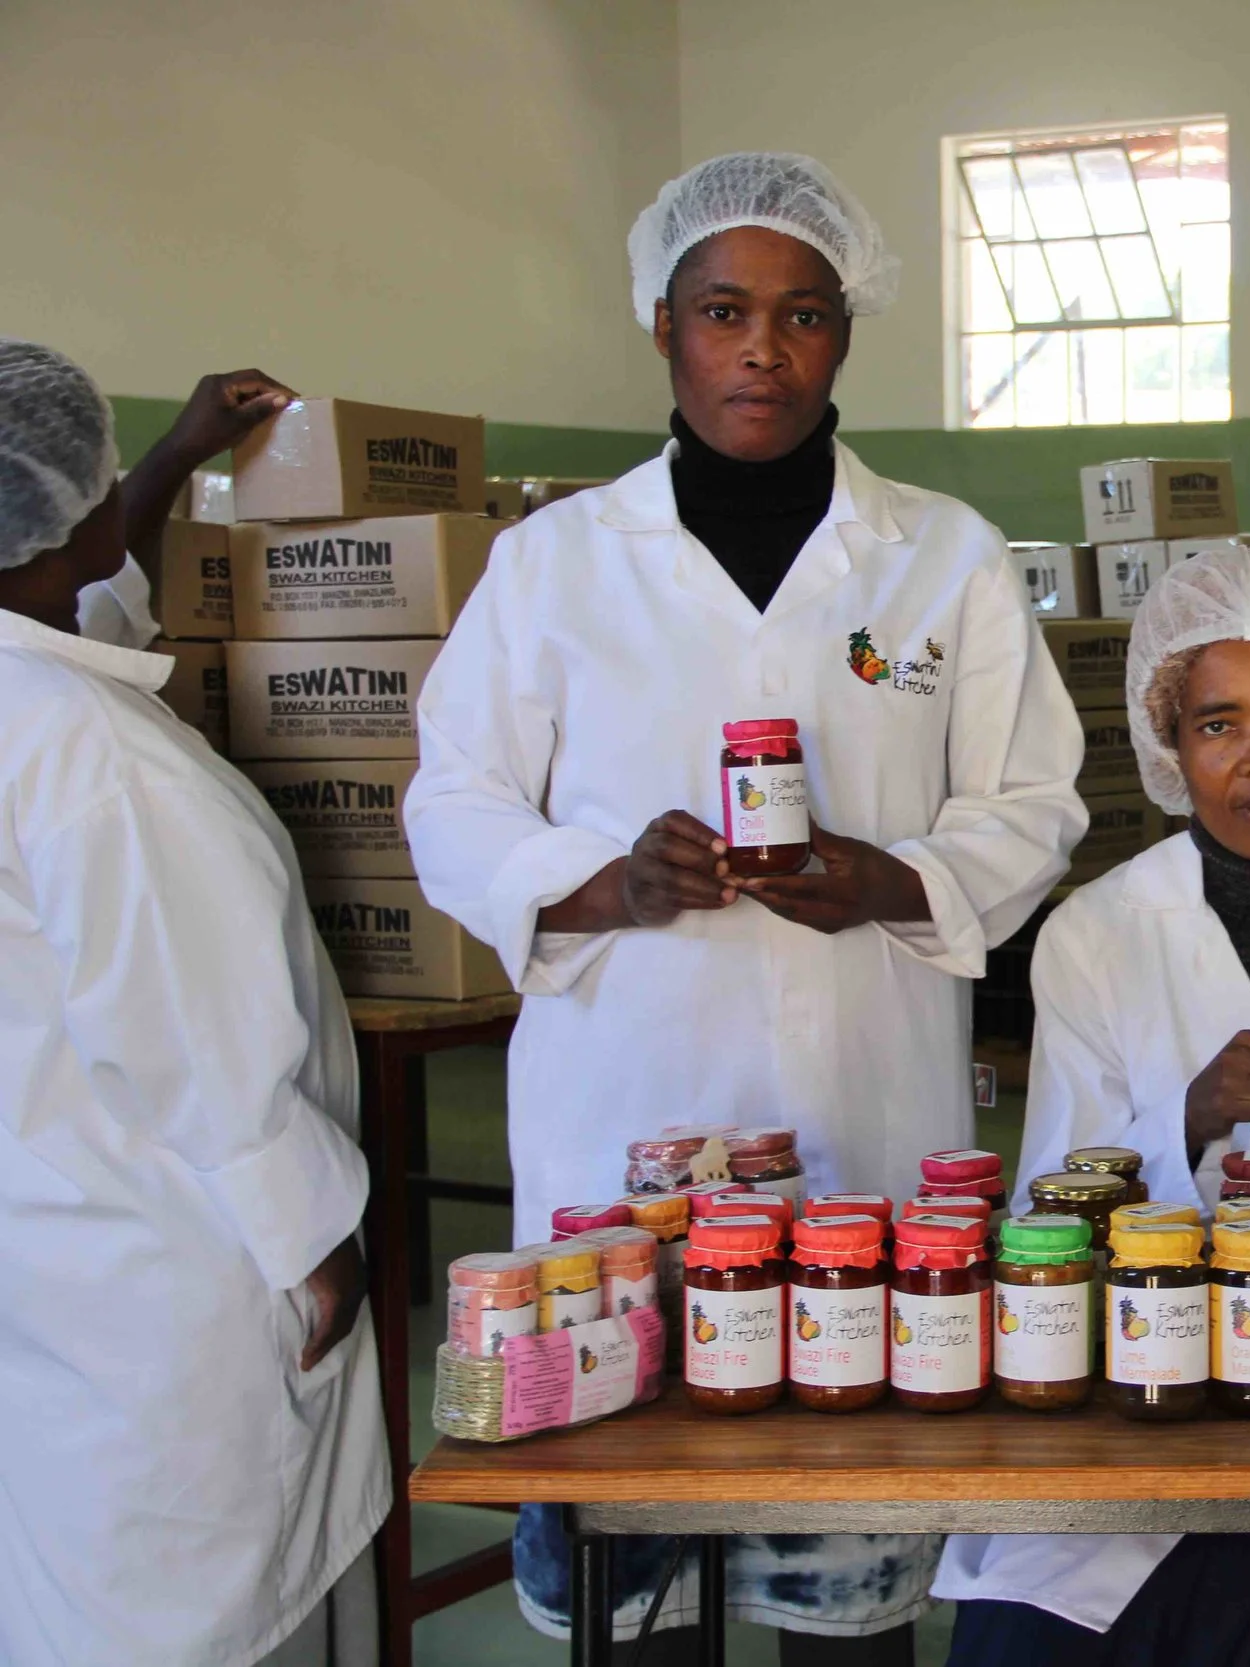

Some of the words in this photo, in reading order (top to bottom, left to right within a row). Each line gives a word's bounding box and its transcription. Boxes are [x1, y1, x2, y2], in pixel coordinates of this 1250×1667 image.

[367, 436, 457, 469] ESWATINI
[266, 538, 392, 568] ESWATINI
[269, 573, 317, 584] SWAZI
[322, 570, 391, 582] KITCHEN
[892, 660, 942, 678] Eswatini
[268, 667, 407, 696] ESWATINI
[894, 674, 937, 696] Kitchen
[271, 701, 324, 711] SWAZI
[330, 700, 407, 711] KITCHEN
[739, 815, 765, 830] Chilli
[740, 831, 767, 842] Sauce
[724, 1321, 777, 1342] Kitchen
[826, 1319, 880, 1340] Kitchen
[1024, 1315, 1080, 1336] Kitchen
[917, 1326, 973, 1348] Kitchen
[724, 1350, 748, 1367] Fire
[826, 1347, 851, 1365] Fire
[919, 1353, 943, 1371] Fire
[1120, 1365, 1182, 1381] Marmalade
